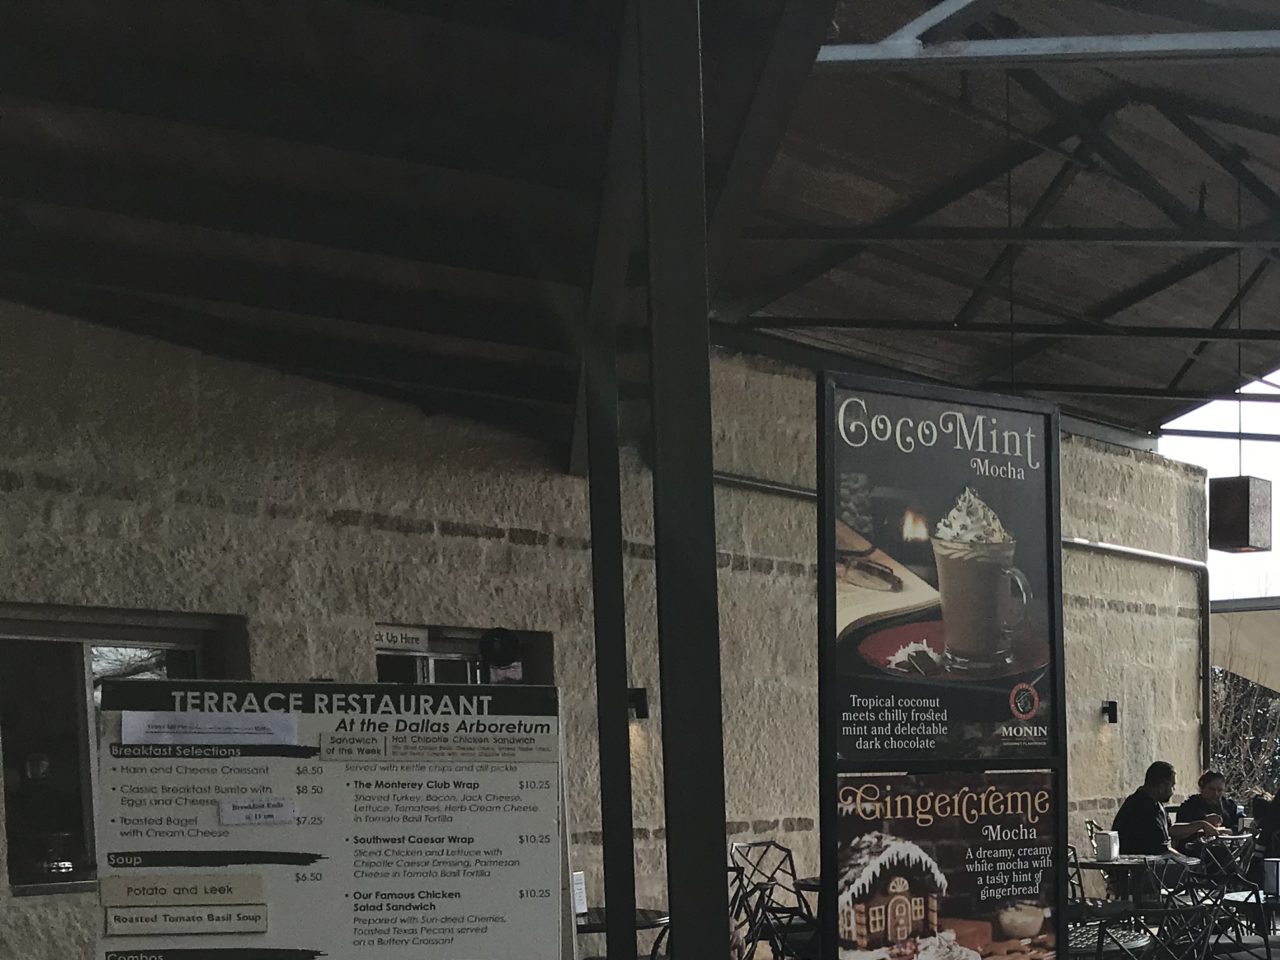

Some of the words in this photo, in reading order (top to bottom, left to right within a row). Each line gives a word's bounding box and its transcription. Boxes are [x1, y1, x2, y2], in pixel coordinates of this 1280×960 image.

[971, 458, 1025, 479] Mocha
[386, 632, 398, 644] Up
[171, 691, 302, 713] TERRACE
[314, 693, 492, 715] RESTAURANT
[850, 695, 895, 709] Tropical
[899, 695, 940, 708] coconut
[842, 710, 875, 722] meets
[879, 709, 908, 724] chilly
[911, 708, 947, 722] frosted
[335, 719, 354, 732] At
[360, 719, 389, 733] the
[395, 719, 450, 733] Dallas
[456, 720, 550, 734] Arboretum
[842, 723, 868, 735] mint
[872, 724, 891, 735] and
[894, 724, 948, 736] delectable
[1001, 726, 1047, 737] MONIN
[855, 736, 881, 749] dark
[884, 737, 935, 750] chocolate
[111, 746, 172, 756] Breakfast
[176, 746, 241, 756] Selections
[354, 781, 372, 789] The
[375, 781, 423, 790] Monterey
[426, 781, 450, 789] Club
[453, 781, 479, 791] Wrap
[519, 781, 551, 790] $10.25
[839, 784, 1050, 827] Gingercreme
[981, 824, 1038, 841] Mocha
[353, 835, 405, 844] Southwest
[408, 836, 445, 844] Caesar
[448, 836, 475, 846] Wrap
[518, 835, 551, 844] $10.25
[966, 848, 973, 859] A
[976, 847, 1015, 861] dreamy,
[1018, 846, 1052, 858] creamy
[109, 855, 142, 866] Soup
[966, 858, 994, 871] white
[997, 859, 1029, 870] mocha
[1031, 856, 1052, 869] with
[295, 873, 322, 882] $6.50
[977, 876, 983, 885] a
[986, 872, 1014, 886] tasty
[1016, 871, 1032, 884] hint
[1034, 869, 1043, 886] of
[127, 887, 167, 897] Potato
[173, 886, 198, 895] and
[353, 892, 373, 900] Our
[375, 891, 415, 899] Famous
[418, 890, 461, 899] Chicken
[518, 890, 551, 899] $10.25
[980, 882, 1040, 900] gingerbread
[353, 903, 383, 912] Salad
[386, 902, 436, 911] Sandwich
[113, 915, 158, 924] Roasted
[163, 914, 203, 923] Tomato
[207, 913, 231, 922] Basil
[236, 913, 261, 923] Soup
